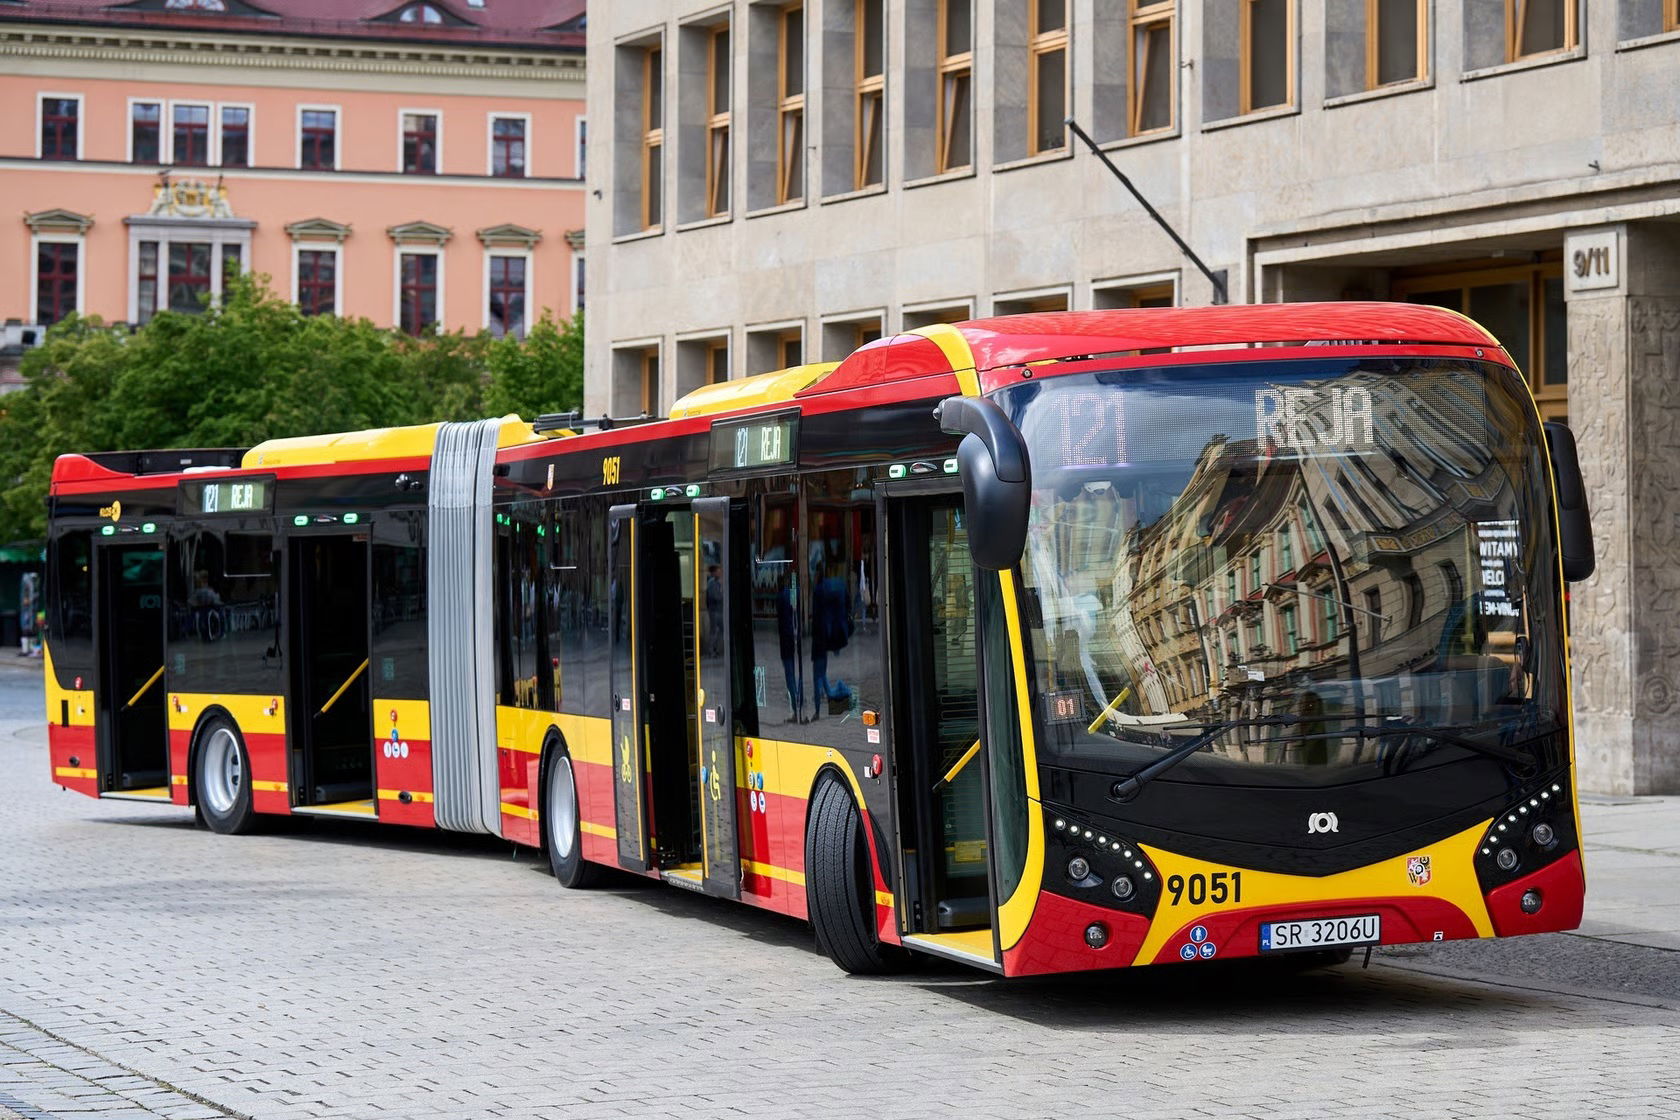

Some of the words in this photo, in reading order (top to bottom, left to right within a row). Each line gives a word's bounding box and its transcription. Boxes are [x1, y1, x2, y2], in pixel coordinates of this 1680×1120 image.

[1573, 246, 1609, 278] 9/11
[1051, 392, 1127, 465] 121
[1255, 387, 1373, 449] REJA
[735, 427, 748, 467] 121
[761, 426, 781, 460] REJA
[602, 456, 620, 485] 9051
[204, 484, 219, 512] 121
[231, 484, 253, 509] REJA
[1057, 698, 1074, 716] 01
[1167, 871, 1241, 906] 9051
[1275, 924, 1302, 946] SR
[1311, 918, 1375, 943] 3206U
